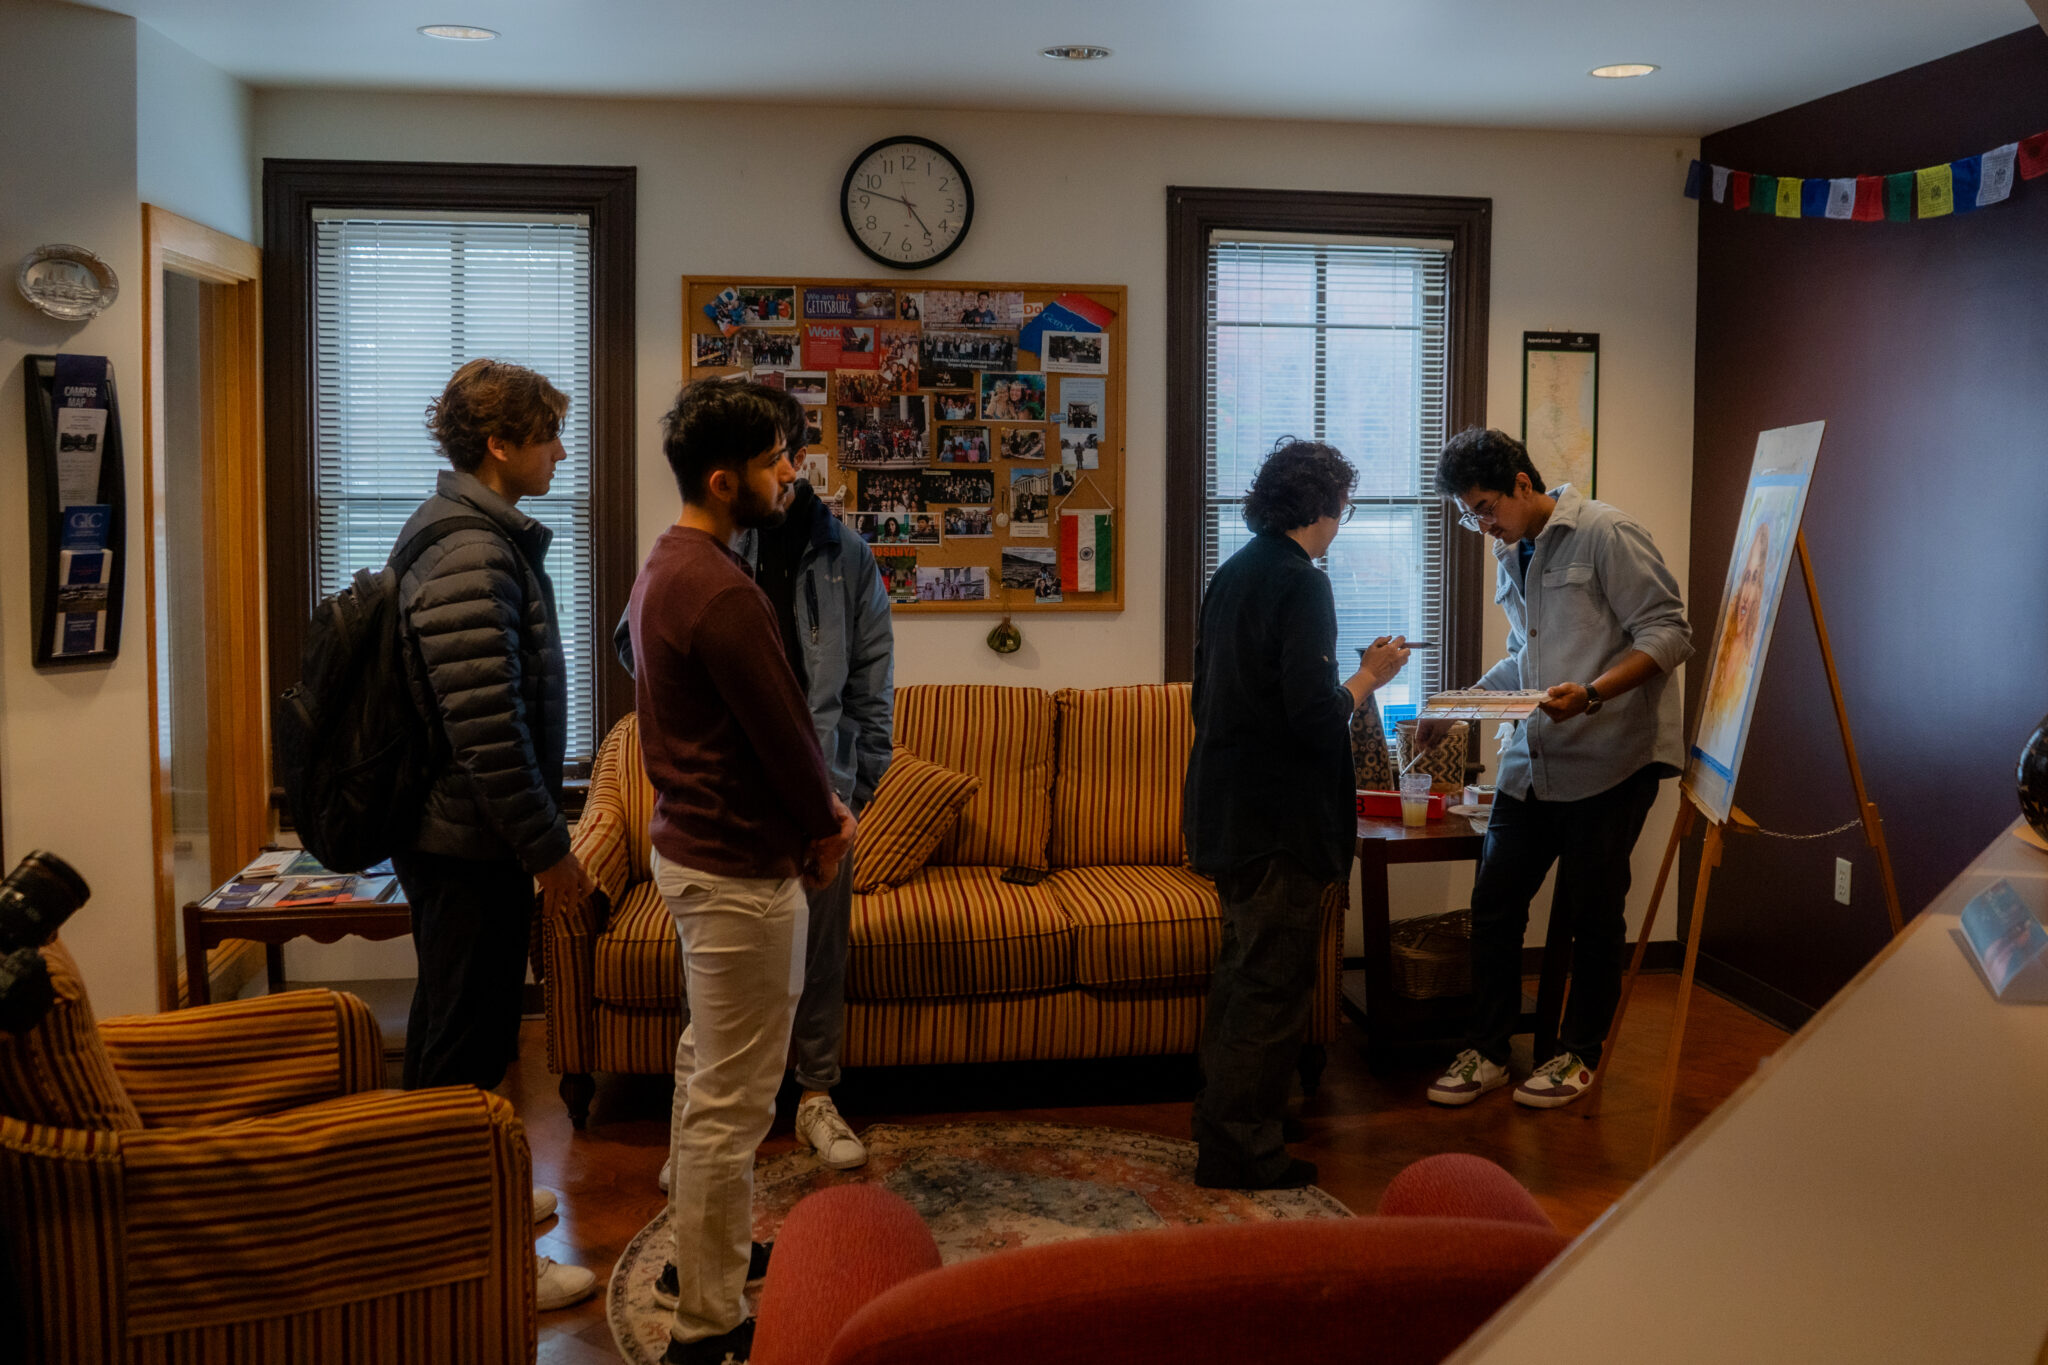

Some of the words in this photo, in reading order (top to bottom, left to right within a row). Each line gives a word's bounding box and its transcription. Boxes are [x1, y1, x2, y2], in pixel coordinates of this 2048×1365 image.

[882, 160, 893, 175] 11
[901, 156, 916, 171] 12
[866, 174, 882, 190] 10
[938, 176, 949, 192] 2
[859, 195, 870, 210] 9
[944, 199, 955, 213] 3
[865, 215, 877, 231] 8
[937, 218, 949, 233] 4
[882, 231, 891, 246] 7
[901, 237, 912, 252] 6
[923, 232, 933, 247] 5
[836, 293, 849, 301] ALL
[806, 300, 852, 314] GETTYSBURG
[1023, 305, 1042, 314] Do
[807, 326, 841, 337] Work
[63, 385, 97, 398] CAMPUS
[67, 397, 87, 408] MAP
